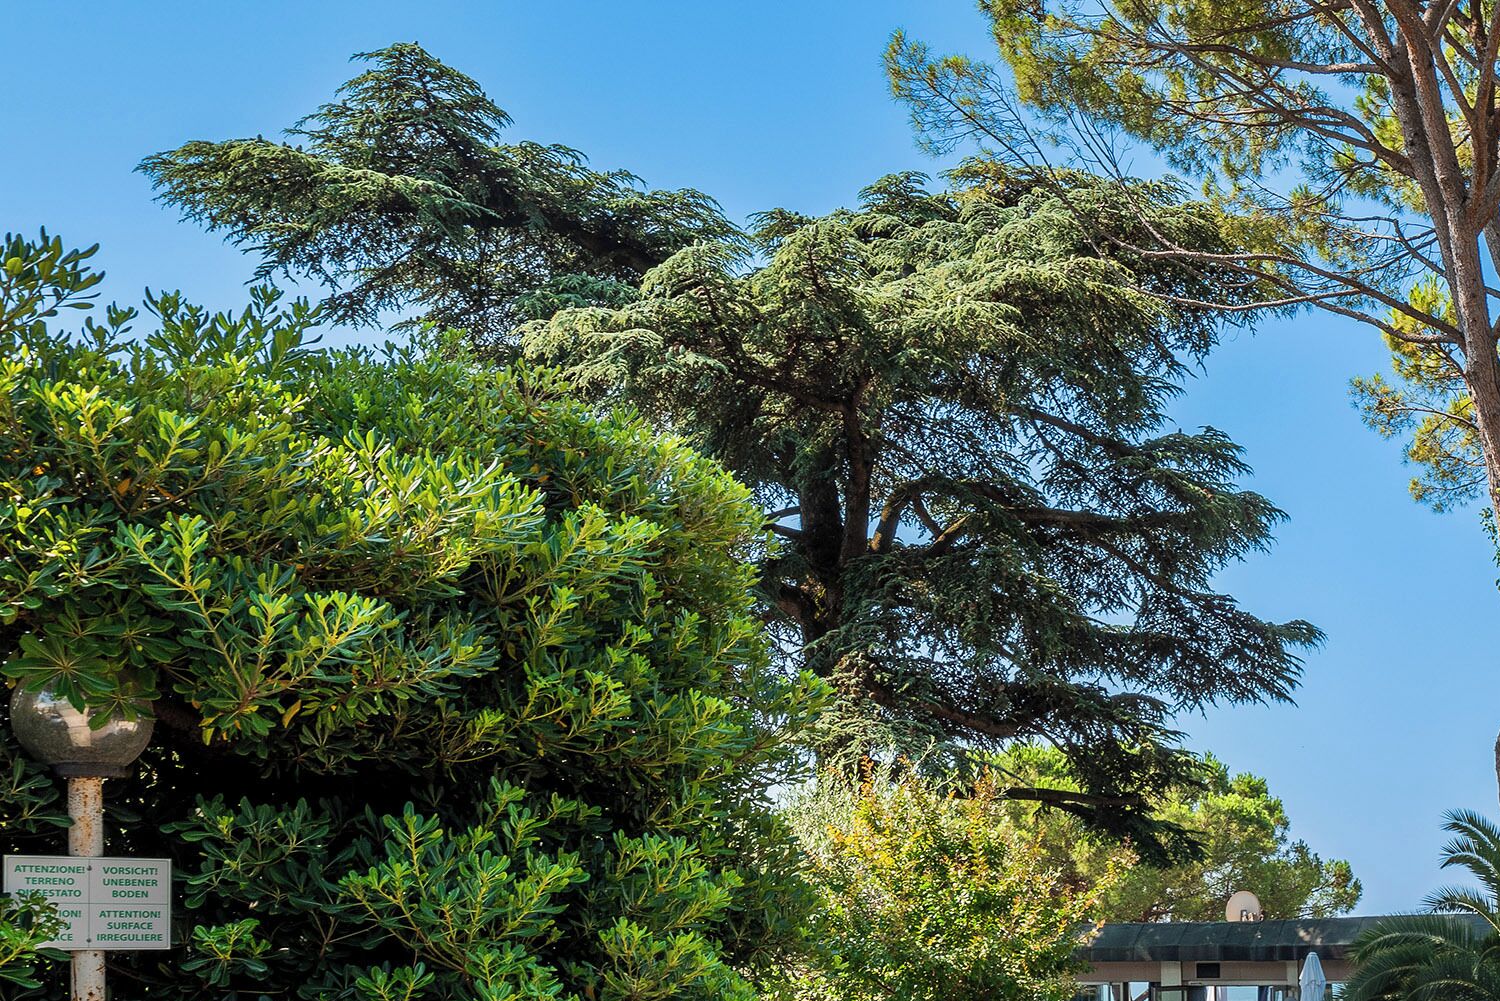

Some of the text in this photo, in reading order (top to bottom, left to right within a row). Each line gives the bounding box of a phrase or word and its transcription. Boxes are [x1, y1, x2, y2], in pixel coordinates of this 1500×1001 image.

[14, 864, 85, 874] ATTENZIONE!
[103, 866, 158, 875] VORSICHT!
[25, 877, 75, 885] TERRENO
[103, 878, 158, 887] UNEBENER
[112, 890, 149, 898] BODEN
[99, 910, 161, 918] ATTENTION!
[107, 922, 153, 930] SURFACE
[96, 933, 163, 941] IRREGULIERE
